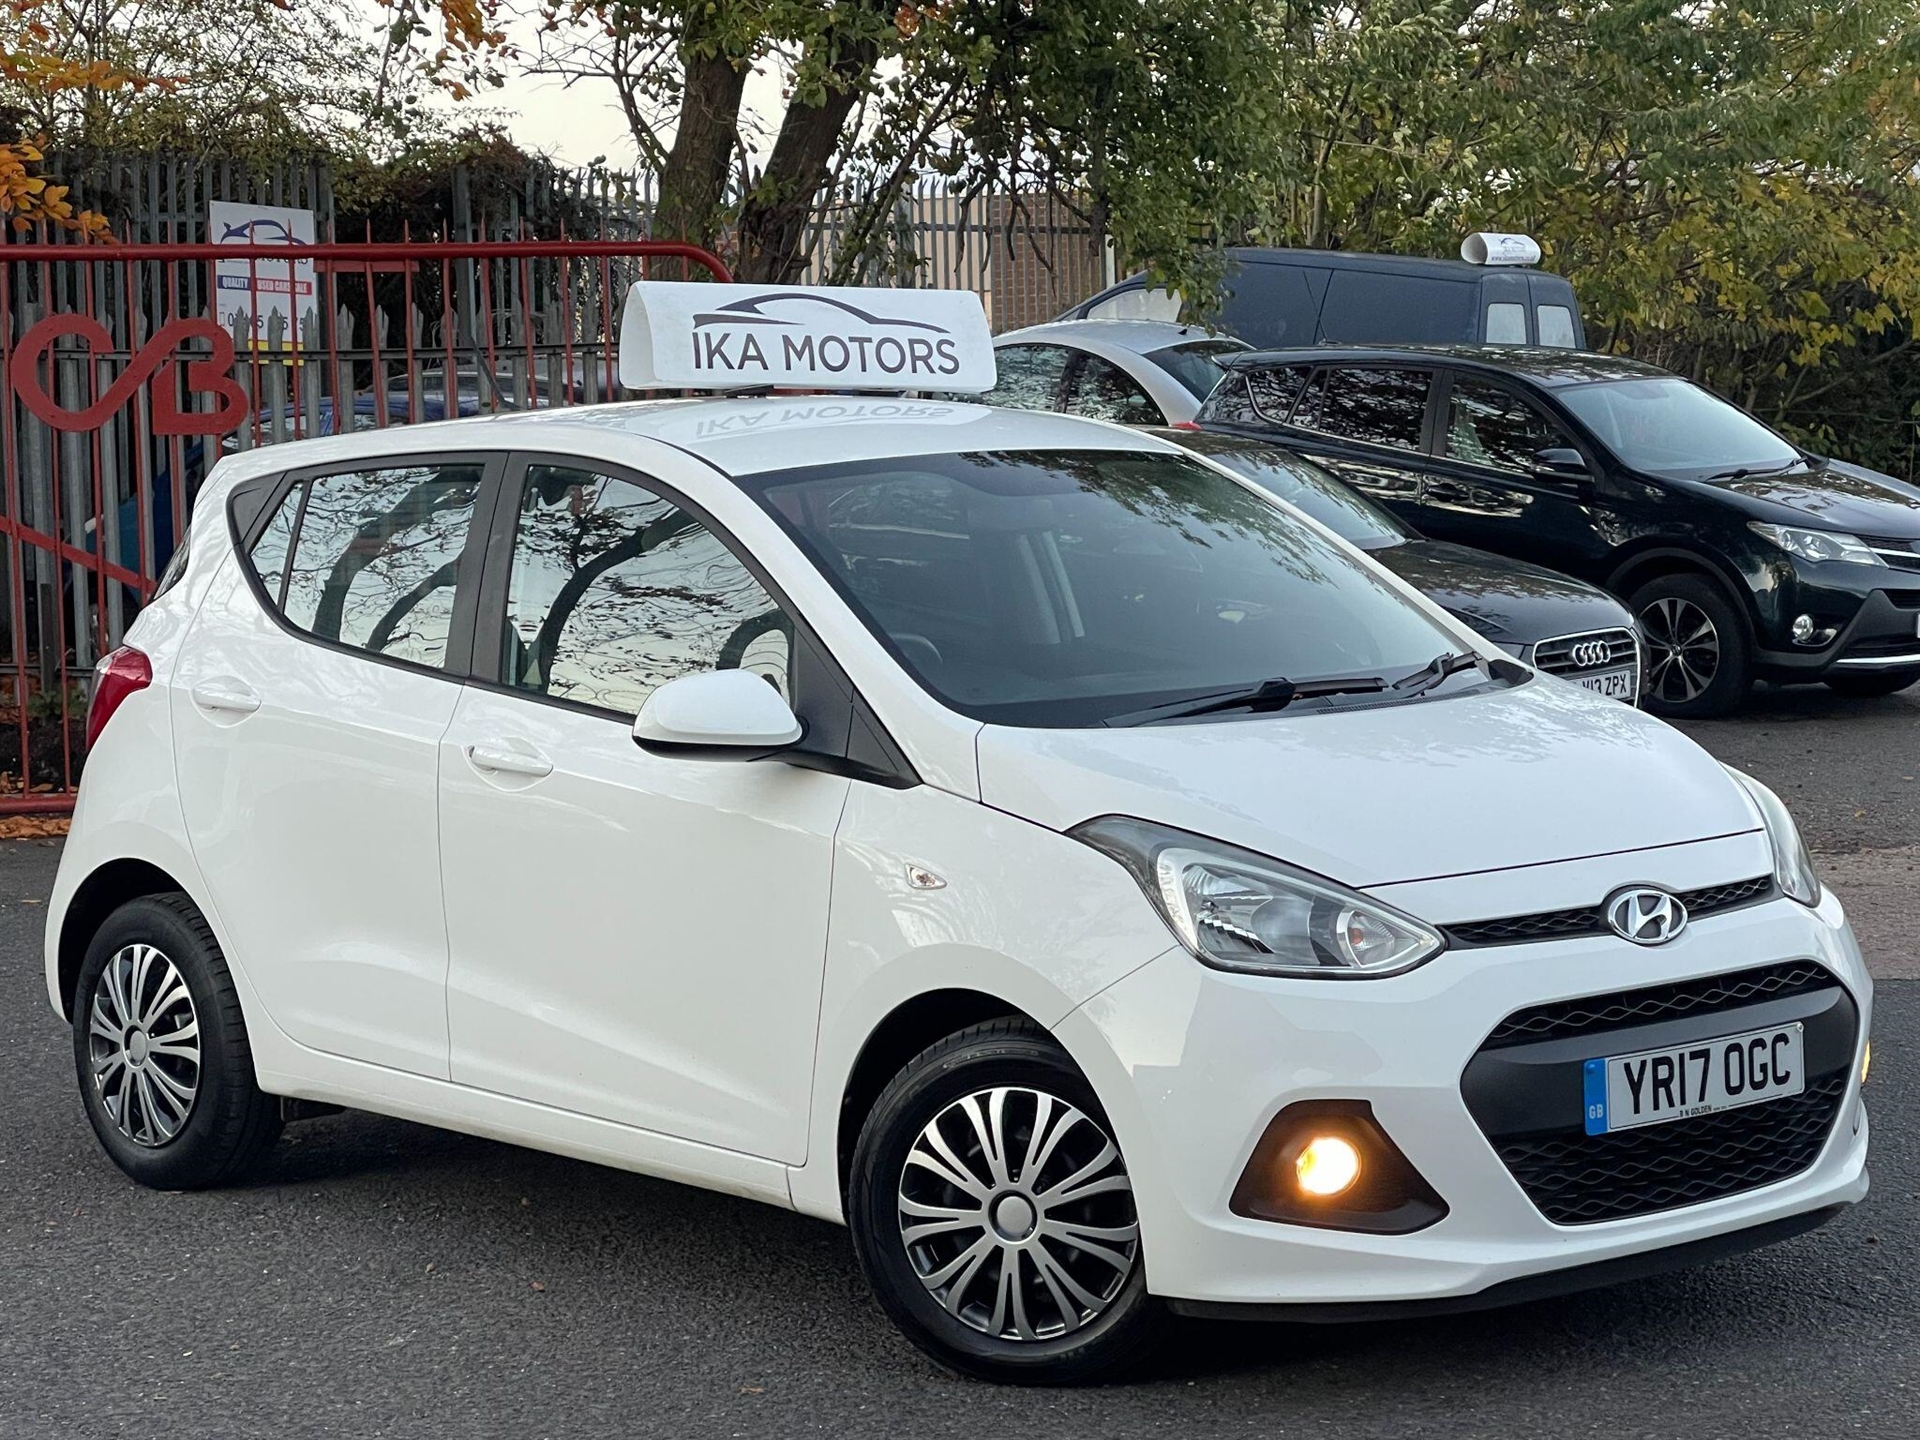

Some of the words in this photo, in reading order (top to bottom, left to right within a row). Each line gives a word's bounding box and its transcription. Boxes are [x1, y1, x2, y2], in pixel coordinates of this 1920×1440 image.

[222, 276, 249, 289] QUALITY
[256, 279, 274, 291] USED
[692, 332, 769, 371] IKA
[782, 334, 960, 375] MOTORS
[1605, 674, 1626, 696] ZPX
[1623, 1047, 1711, 1115] YR17
[1724, 1032, 1791, 1096] OGC
[1588, 1104, 1603, 1119] GB
[1691, 1105, 1712, 1115] GOLDEN
